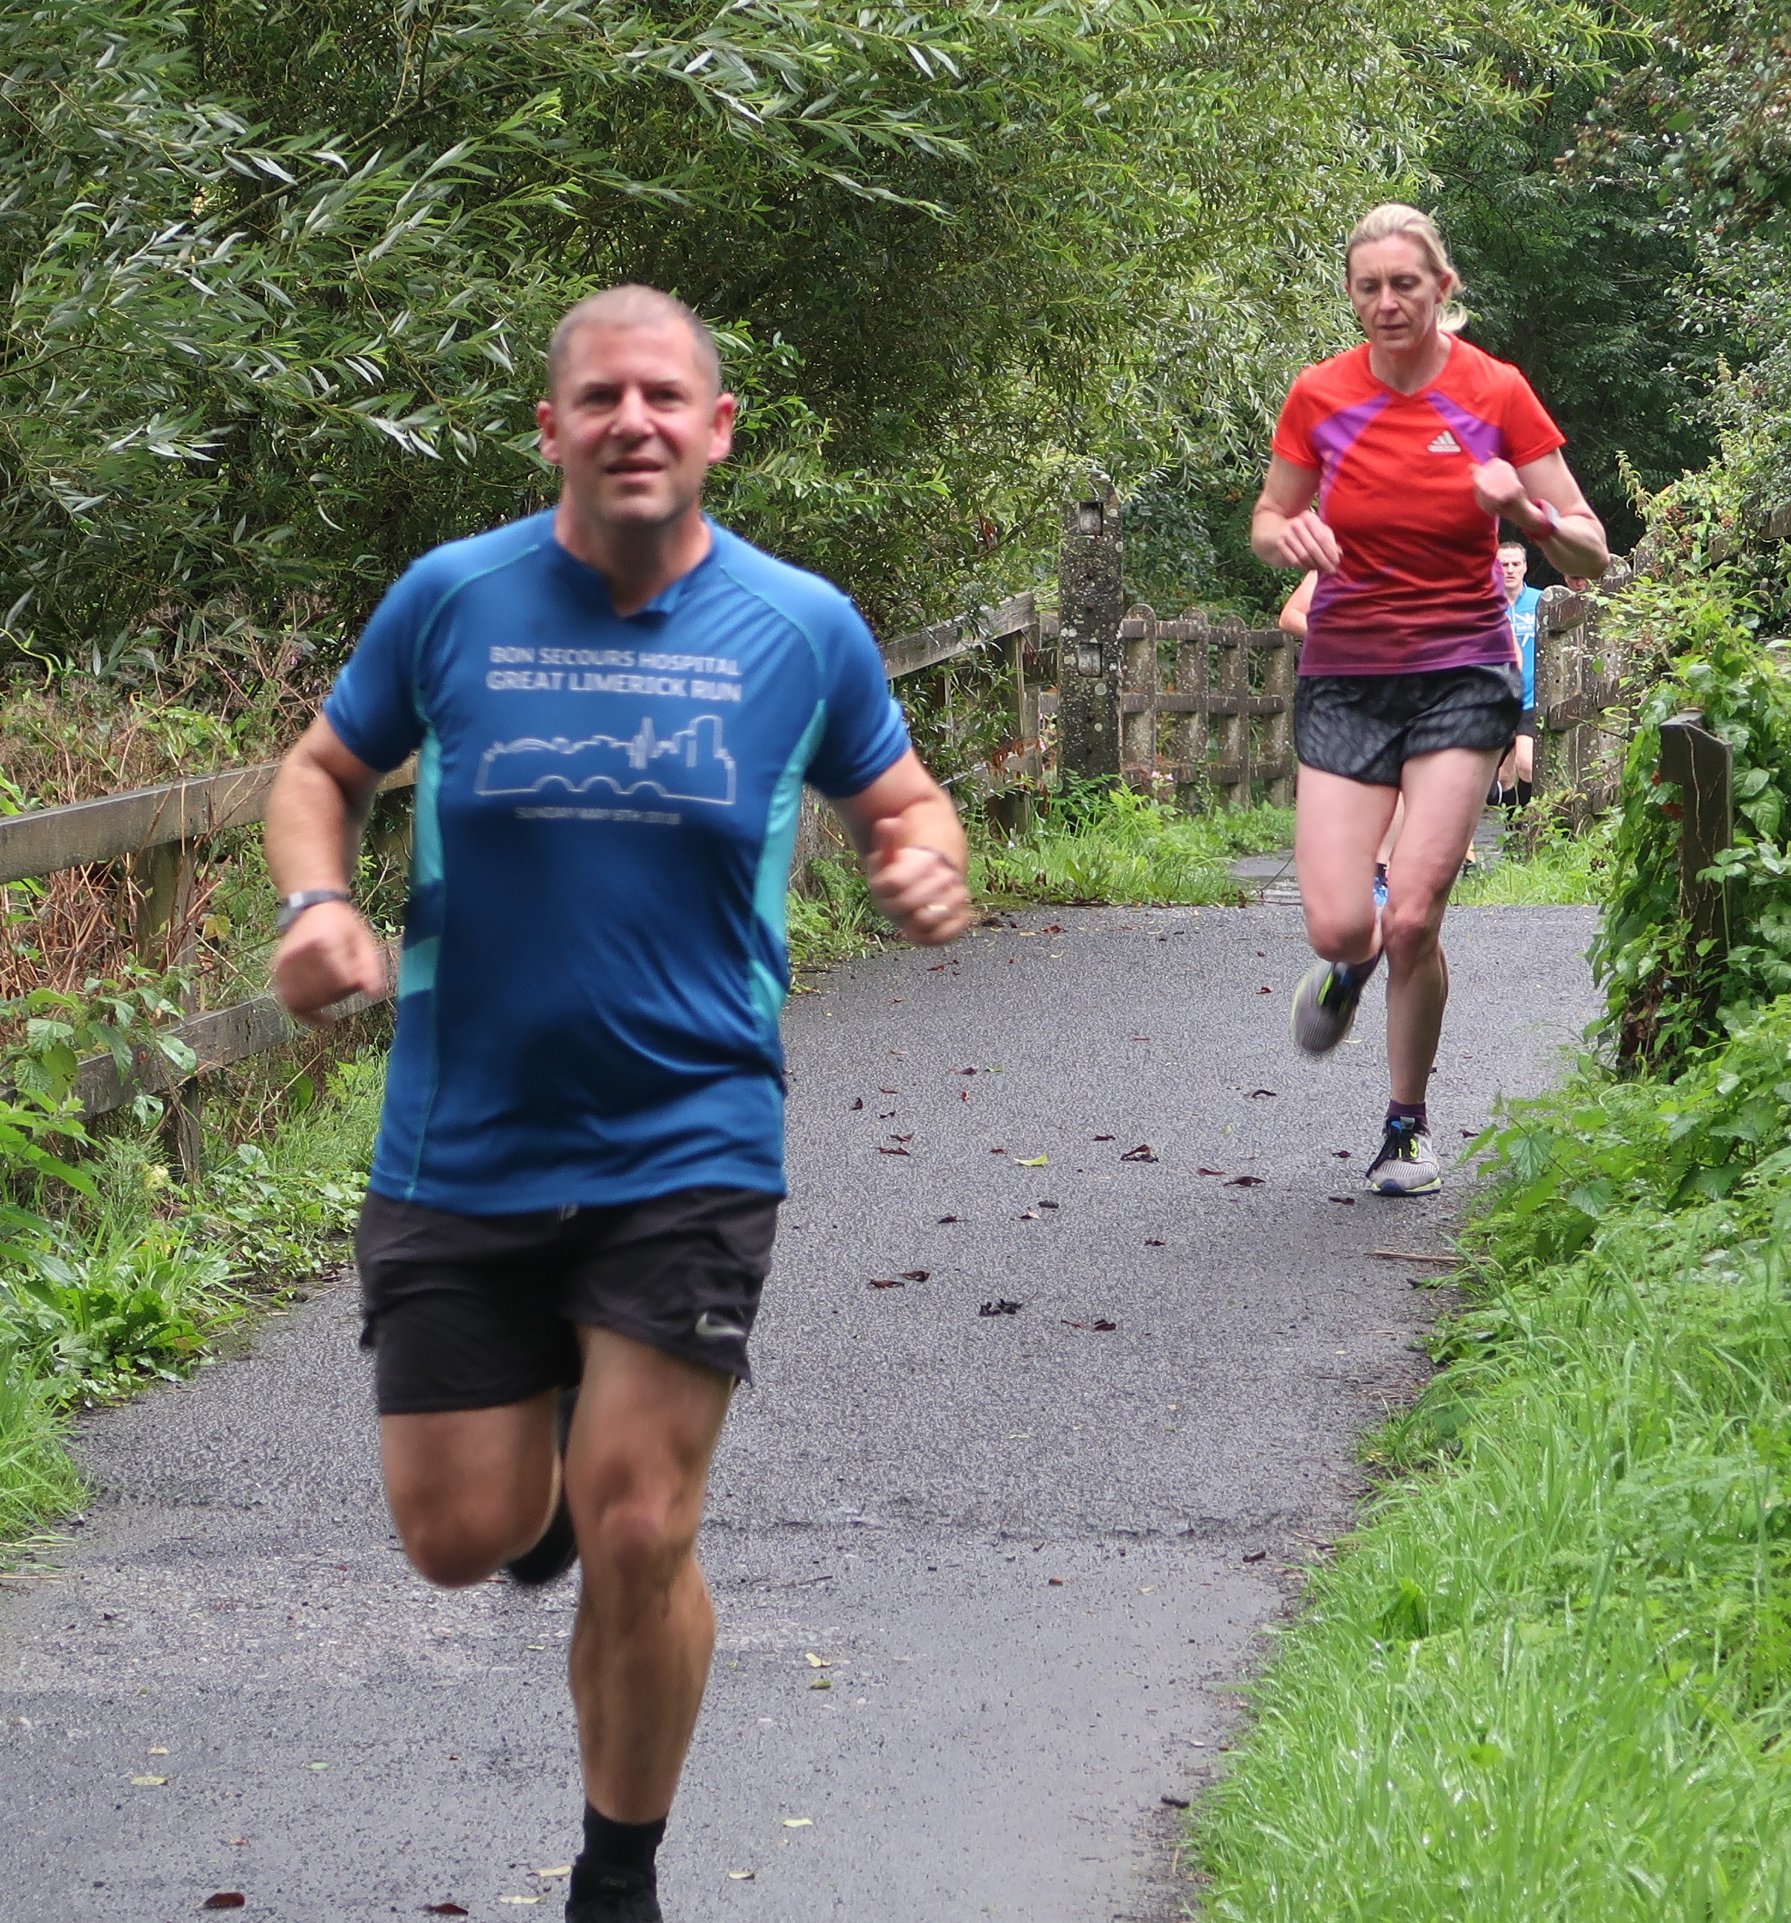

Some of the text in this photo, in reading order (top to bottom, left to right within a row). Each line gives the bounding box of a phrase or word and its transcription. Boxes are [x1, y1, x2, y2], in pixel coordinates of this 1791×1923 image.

[489, 646, 742, 675] BON SECOURS HOSPITAL
[486, 671, 742, 701] GREAT LIMERICK RUN
